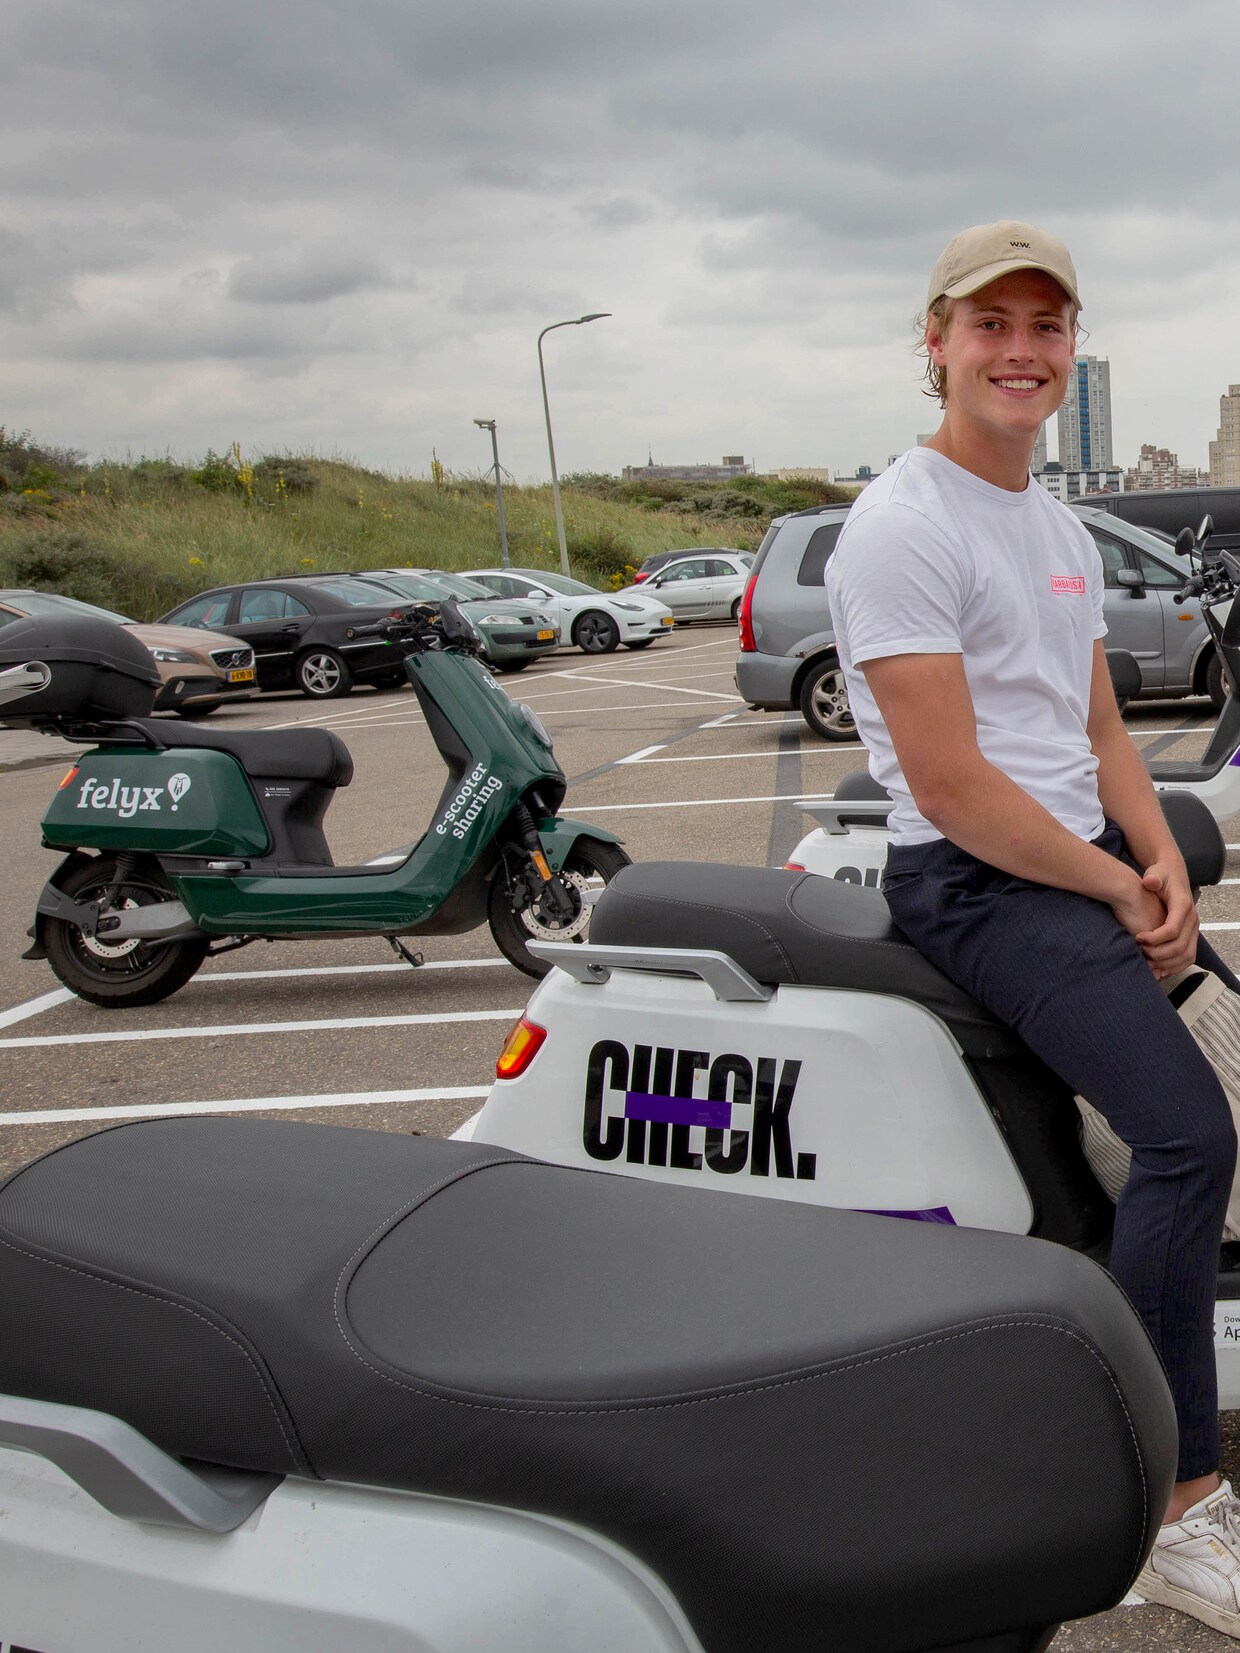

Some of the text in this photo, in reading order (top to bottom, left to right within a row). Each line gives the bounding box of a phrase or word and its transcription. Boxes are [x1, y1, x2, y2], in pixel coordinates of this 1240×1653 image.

[77, 778, 164, 818] felyx
[436, 762, 487, 835] e-scooter
[452, 775, 503, 840] sharing
